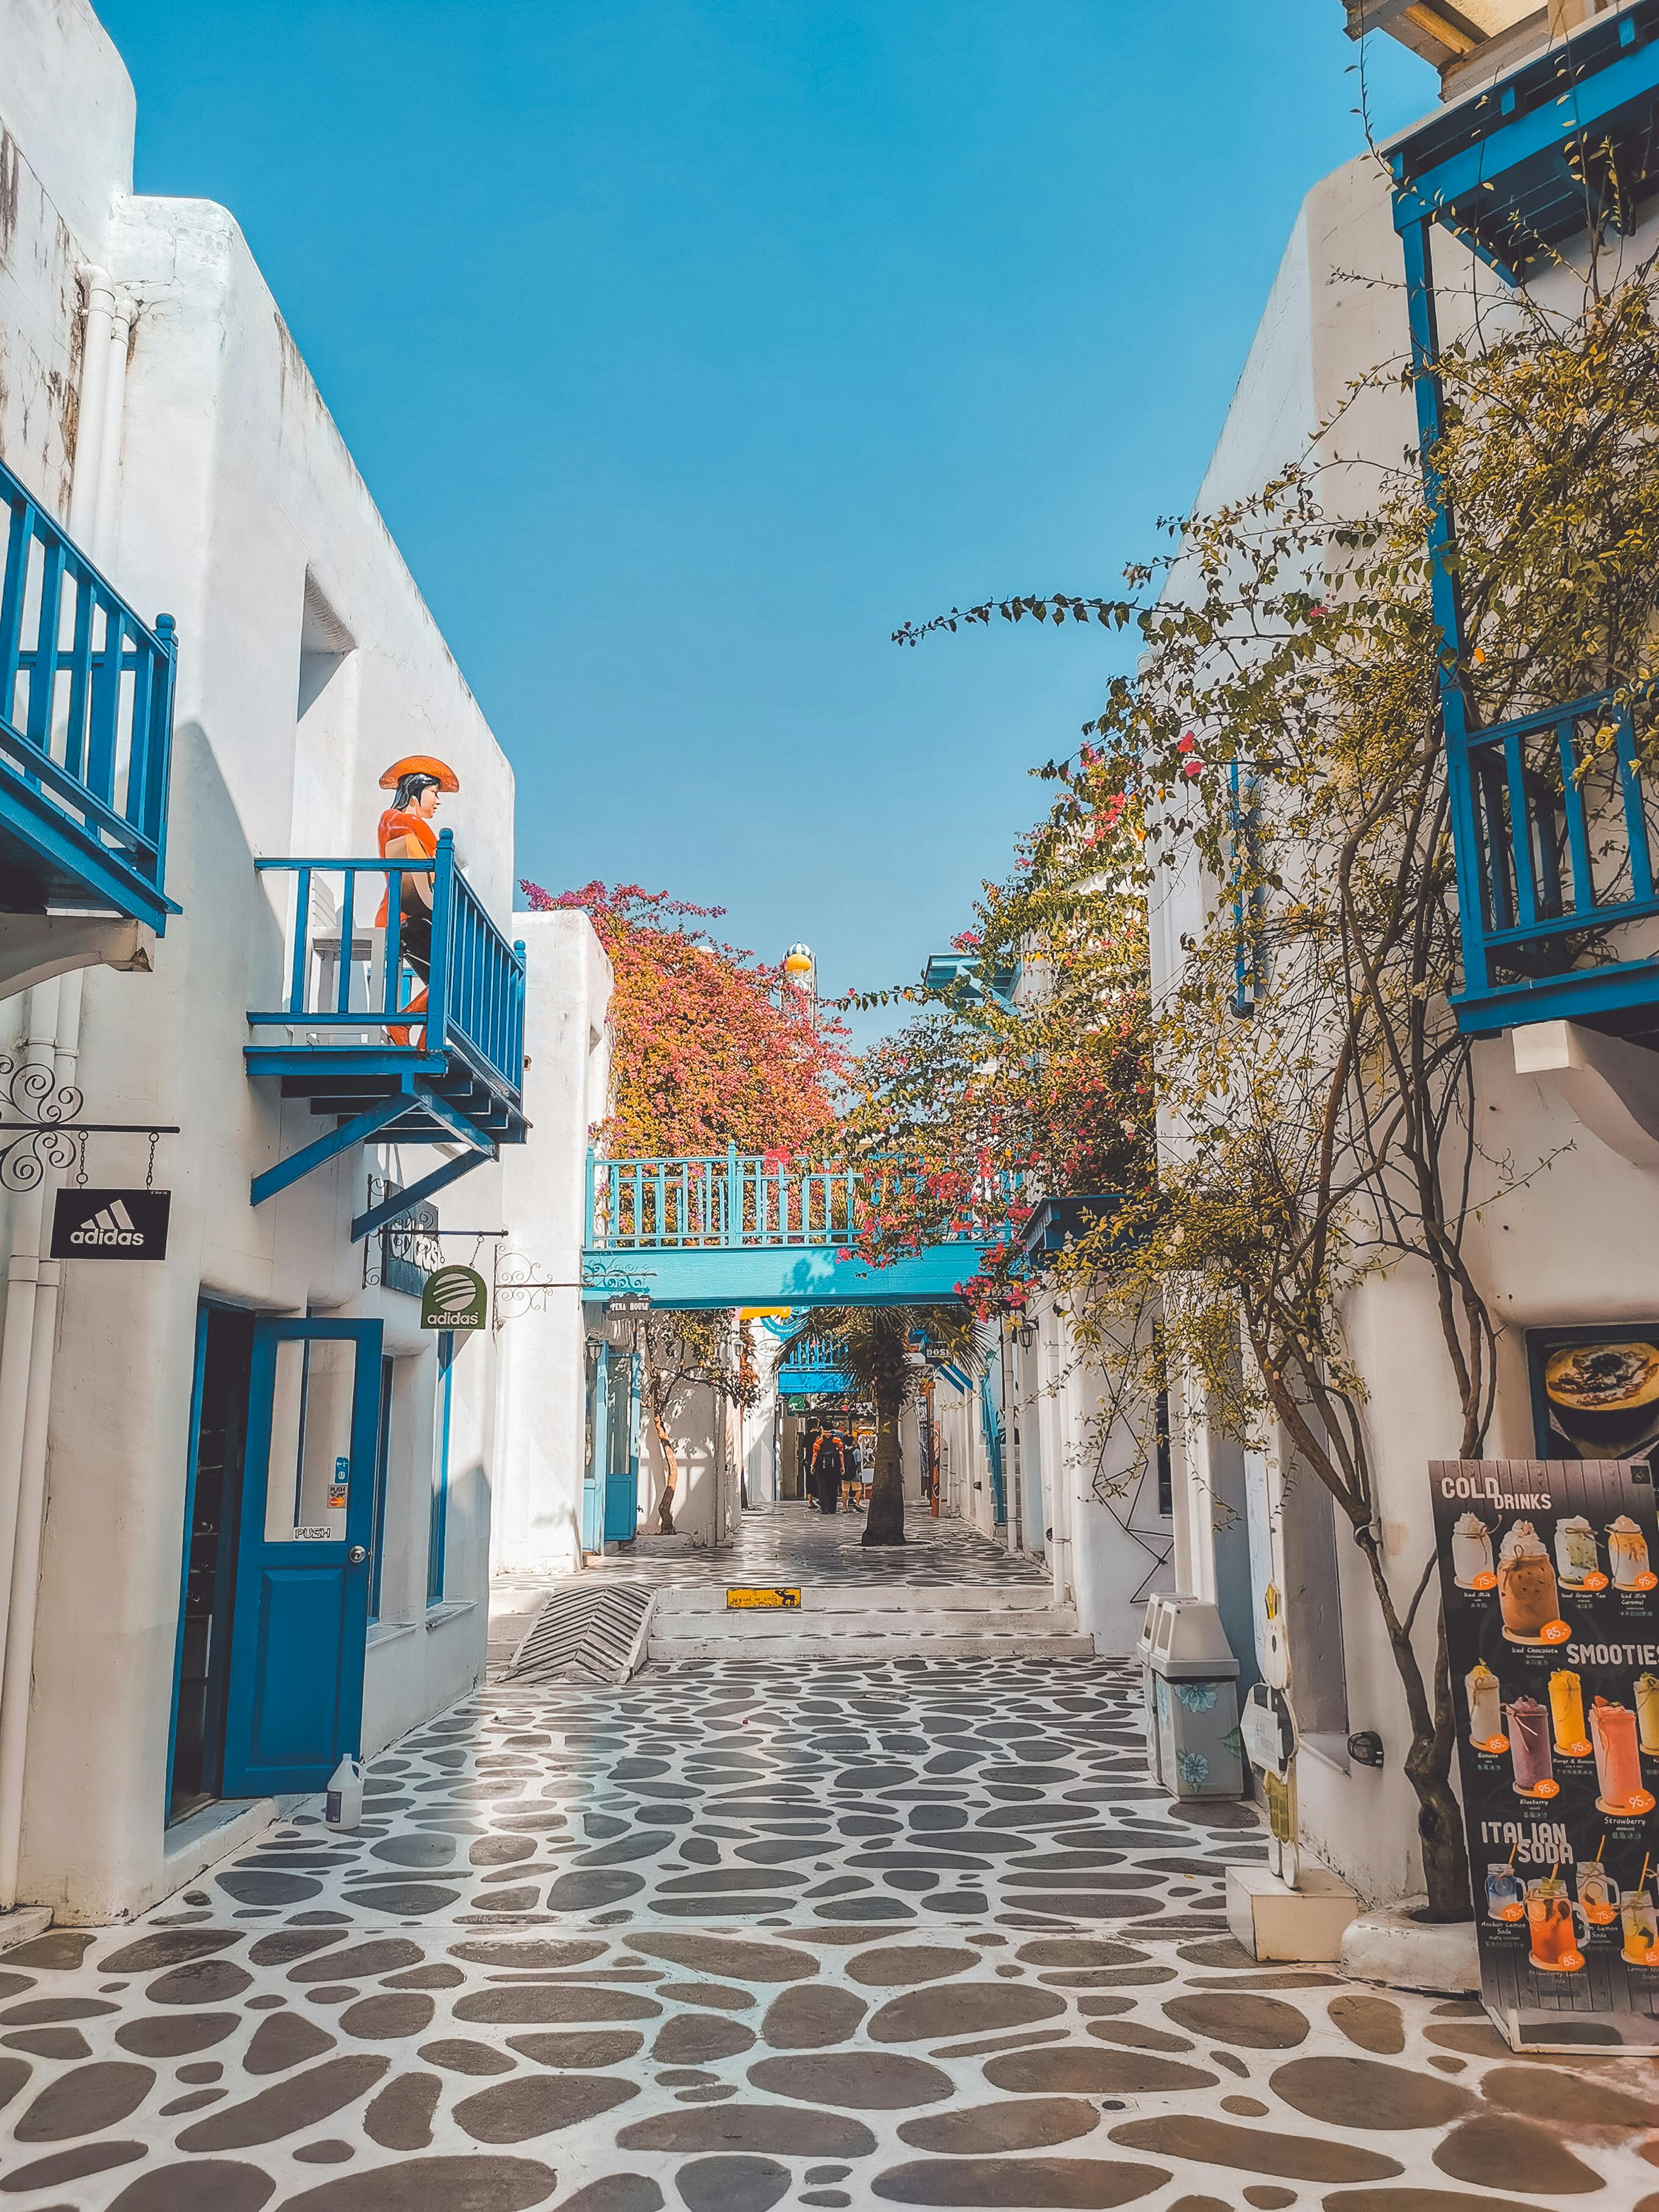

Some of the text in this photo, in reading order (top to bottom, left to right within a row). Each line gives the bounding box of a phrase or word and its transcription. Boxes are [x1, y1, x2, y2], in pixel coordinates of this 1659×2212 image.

[70, 1228, 144, 1245] adidas
[630, 1302, 649, 1311] HOUSE
[427, 1312, 478, 1325] adidas
[1441, 1477, 1500, 1499] COLD
[1494, 1493, 1552, 1510] DRINKS
[295, 1527, 331, 1539] PUSH
[1566, 1644, 1659, 1665] SMOOTIE
[1604, 1816, 1646, 1826] Strawberry
[1481, 1821, 1567, 1845] ITALIAN
[1517, 1842, 1574, 1865] SODA
